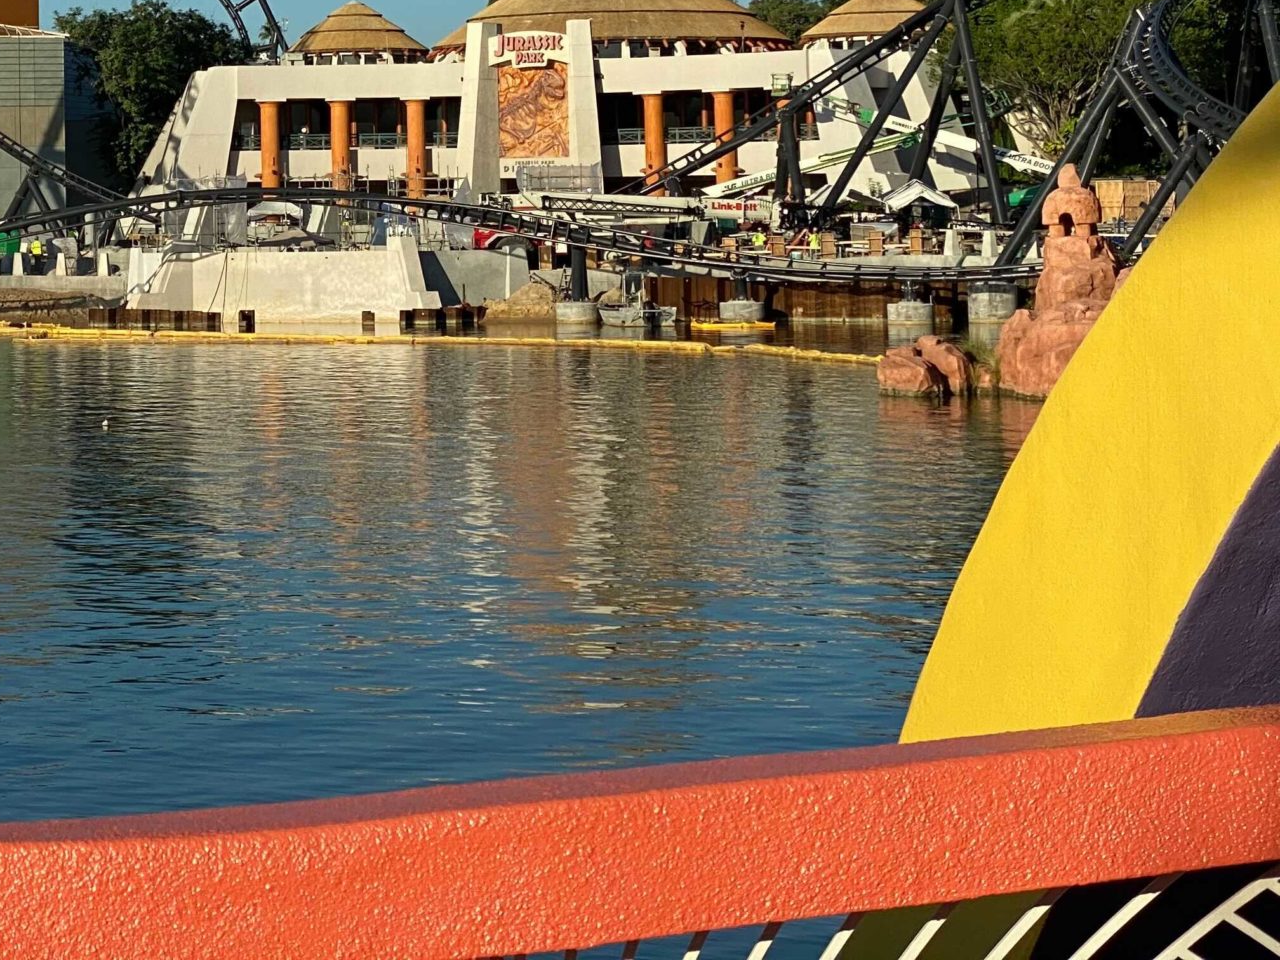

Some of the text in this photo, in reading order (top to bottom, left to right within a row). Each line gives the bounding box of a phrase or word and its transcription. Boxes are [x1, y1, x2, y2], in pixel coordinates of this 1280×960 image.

[494, 34, 564, 57] JURASSIC
[515, 52, 545, 65] PARK
[712, 202, 758, 211] Link-Belt
